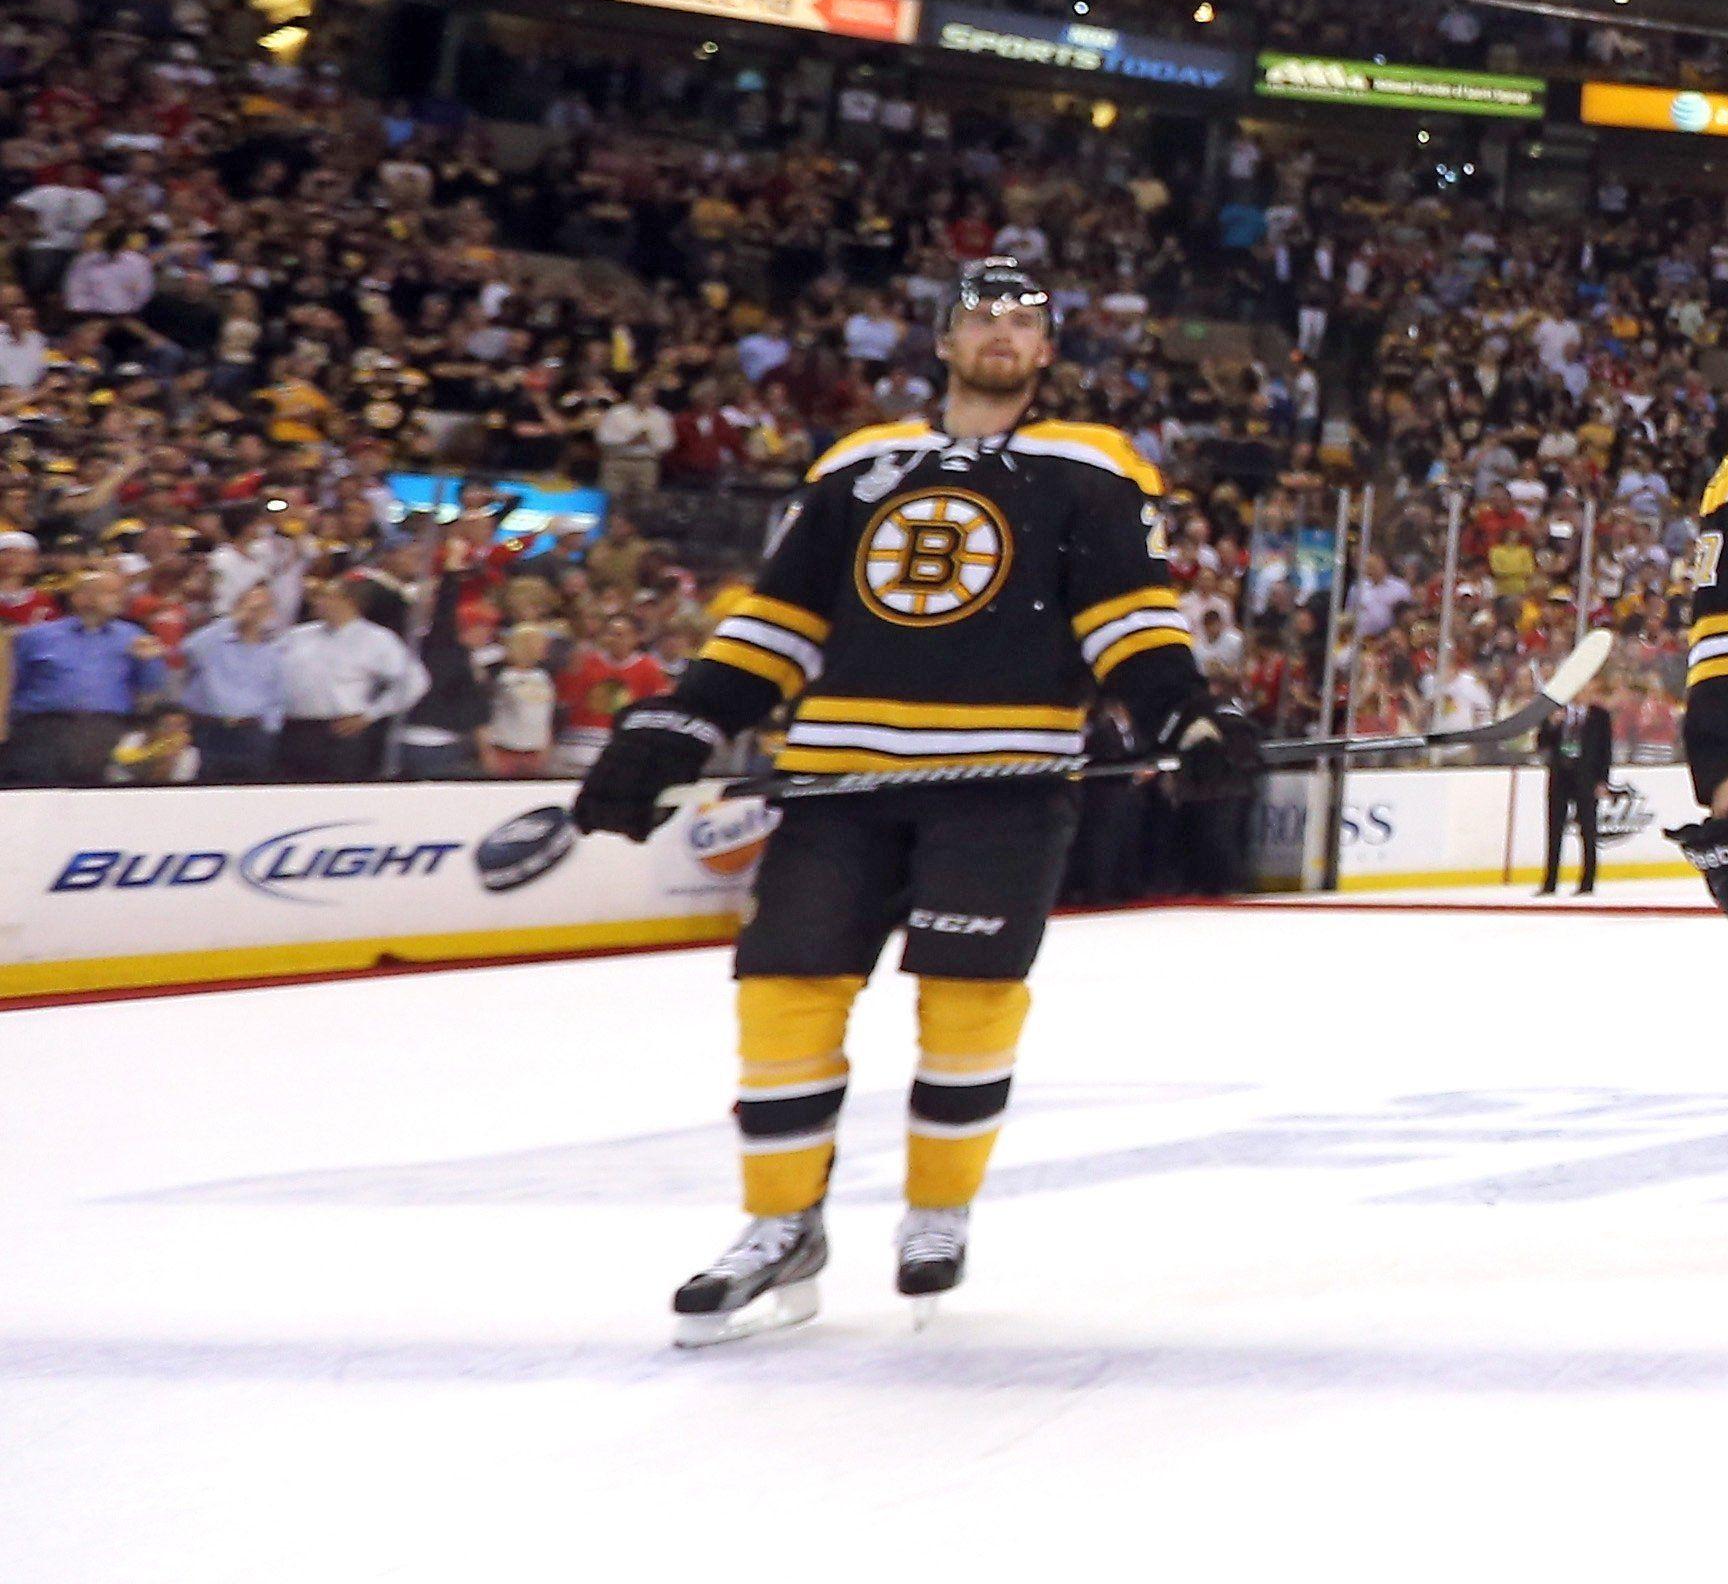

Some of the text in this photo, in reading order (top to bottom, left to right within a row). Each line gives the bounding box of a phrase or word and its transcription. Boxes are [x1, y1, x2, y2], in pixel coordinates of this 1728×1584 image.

[50, 842, 464, 894] BUD LIGHT
[908, 910, 1005, 935] CCM
